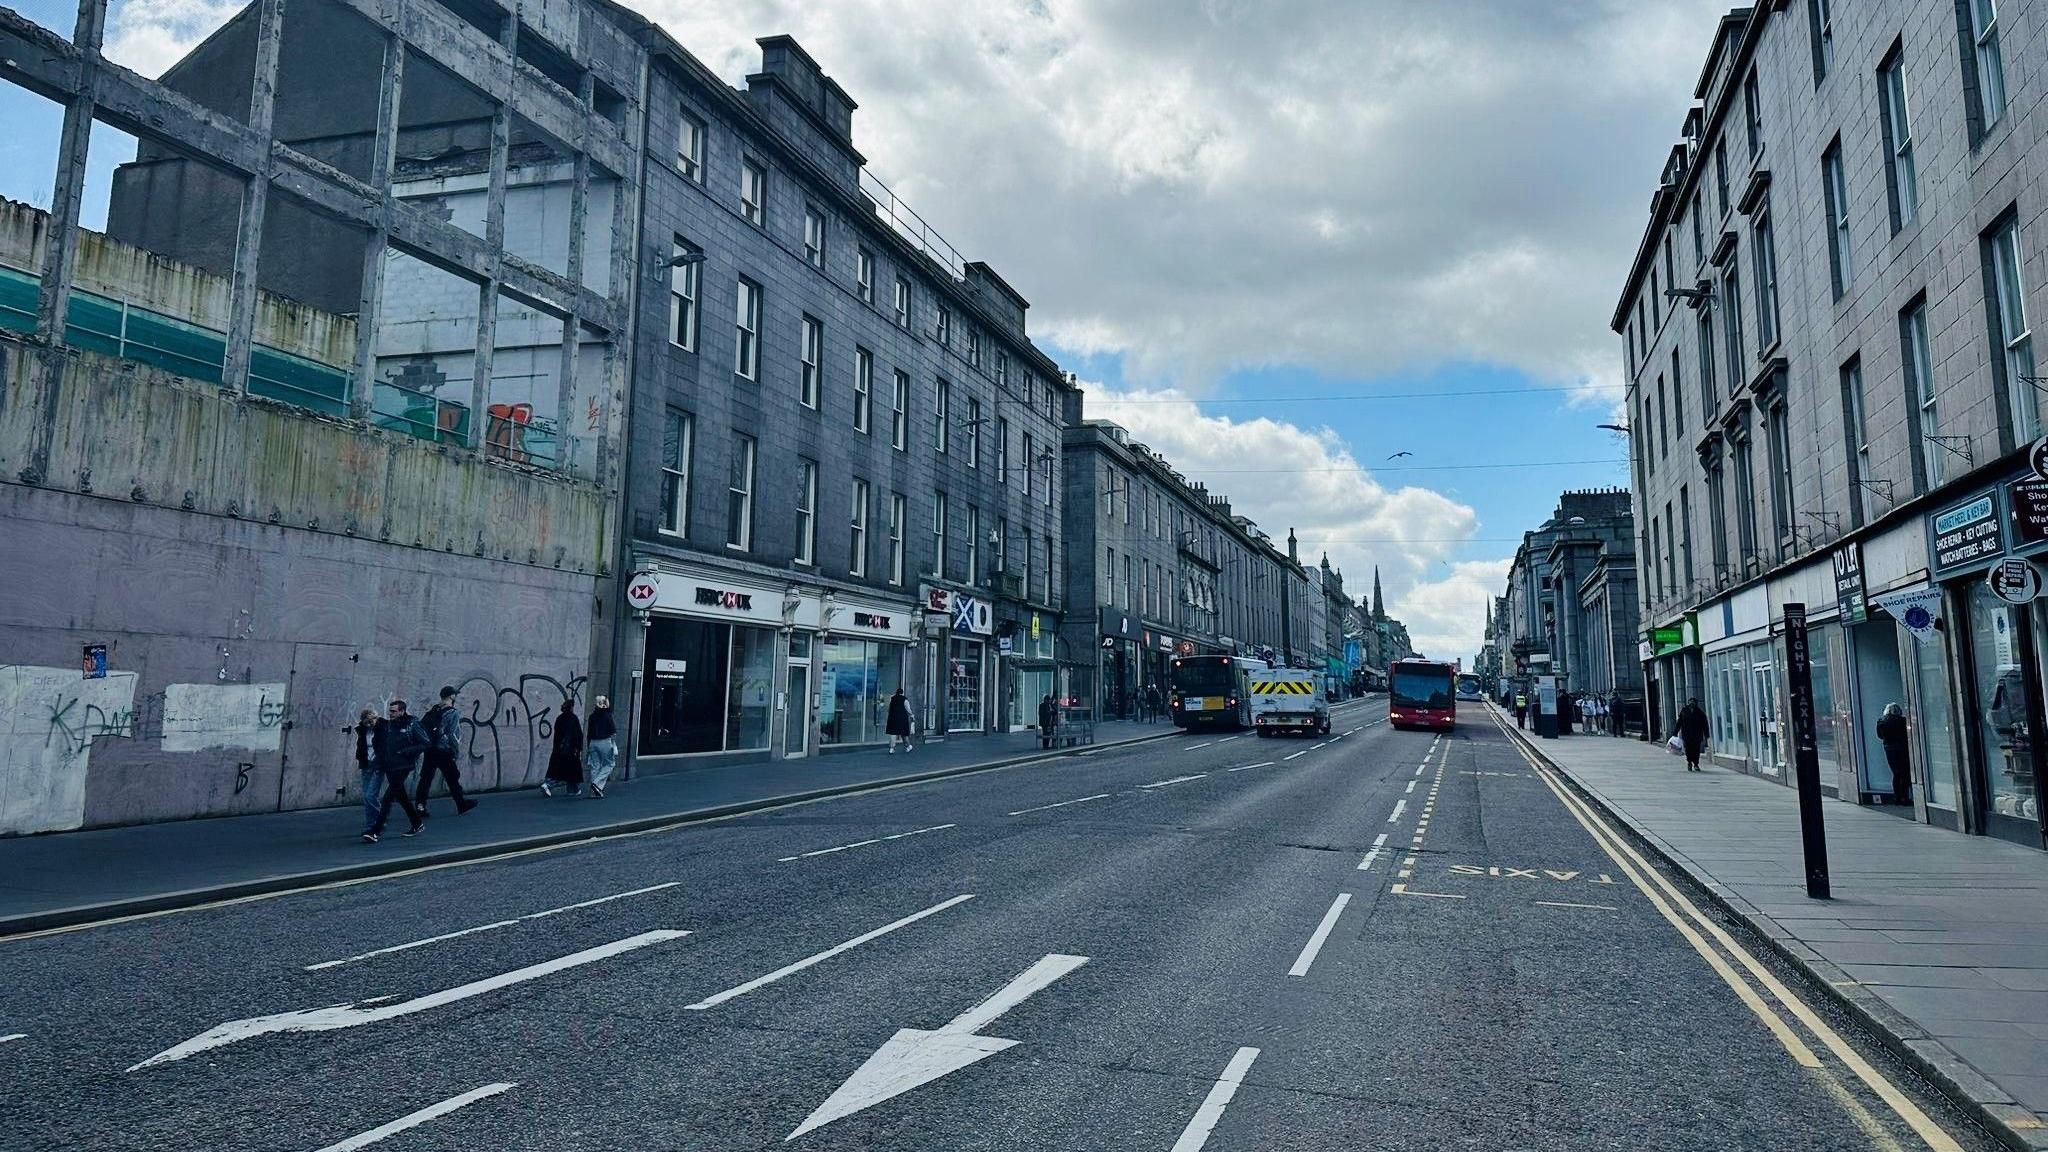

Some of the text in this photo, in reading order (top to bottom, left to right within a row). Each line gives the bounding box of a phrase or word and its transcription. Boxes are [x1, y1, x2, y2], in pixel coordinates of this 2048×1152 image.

[1966, 527, 1975, 540] KEY
[1975, 519, 1998, 537] CUTTING
[1982, 537, 1996, 552] BAGS
[1833, 542, 1859, 577] TO LET
[1883, 592, 1941, 607] SHOE REPAIRS
[1102, 638, 1114, 647] JD
[1791, 618, 1805, 672] NIGHT
[1448, 865, 1625, 885] TAXIS
